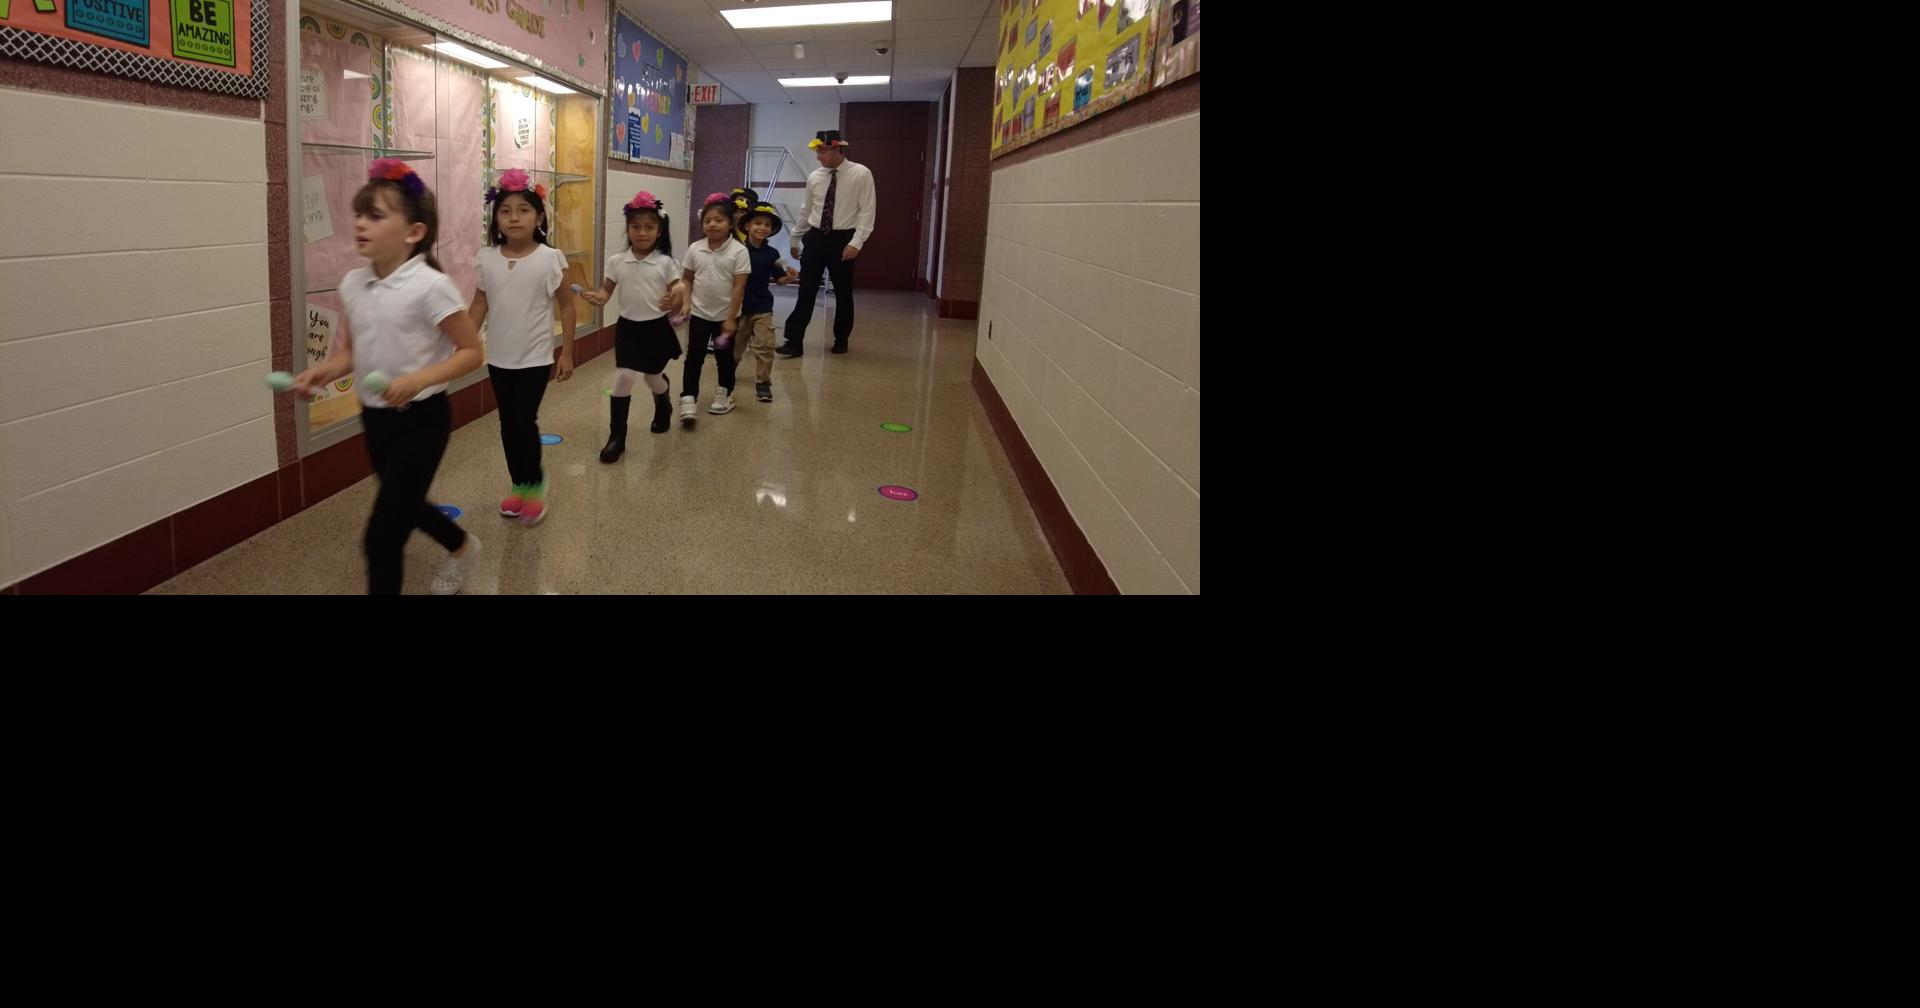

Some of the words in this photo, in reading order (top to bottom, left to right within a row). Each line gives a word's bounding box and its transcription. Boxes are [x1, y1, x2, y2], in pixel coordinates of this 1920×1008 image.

[75, 0, 143, 23] OSITIVE
[190, 0, 217, 26] BE
[178, 22, 230, 46] AMAZING
[695, 85, 717, 102] EXIT
[309, 310, 329, 328] You
[308, 332, 324, 342] are
[306, 346, 327, 361] ough
